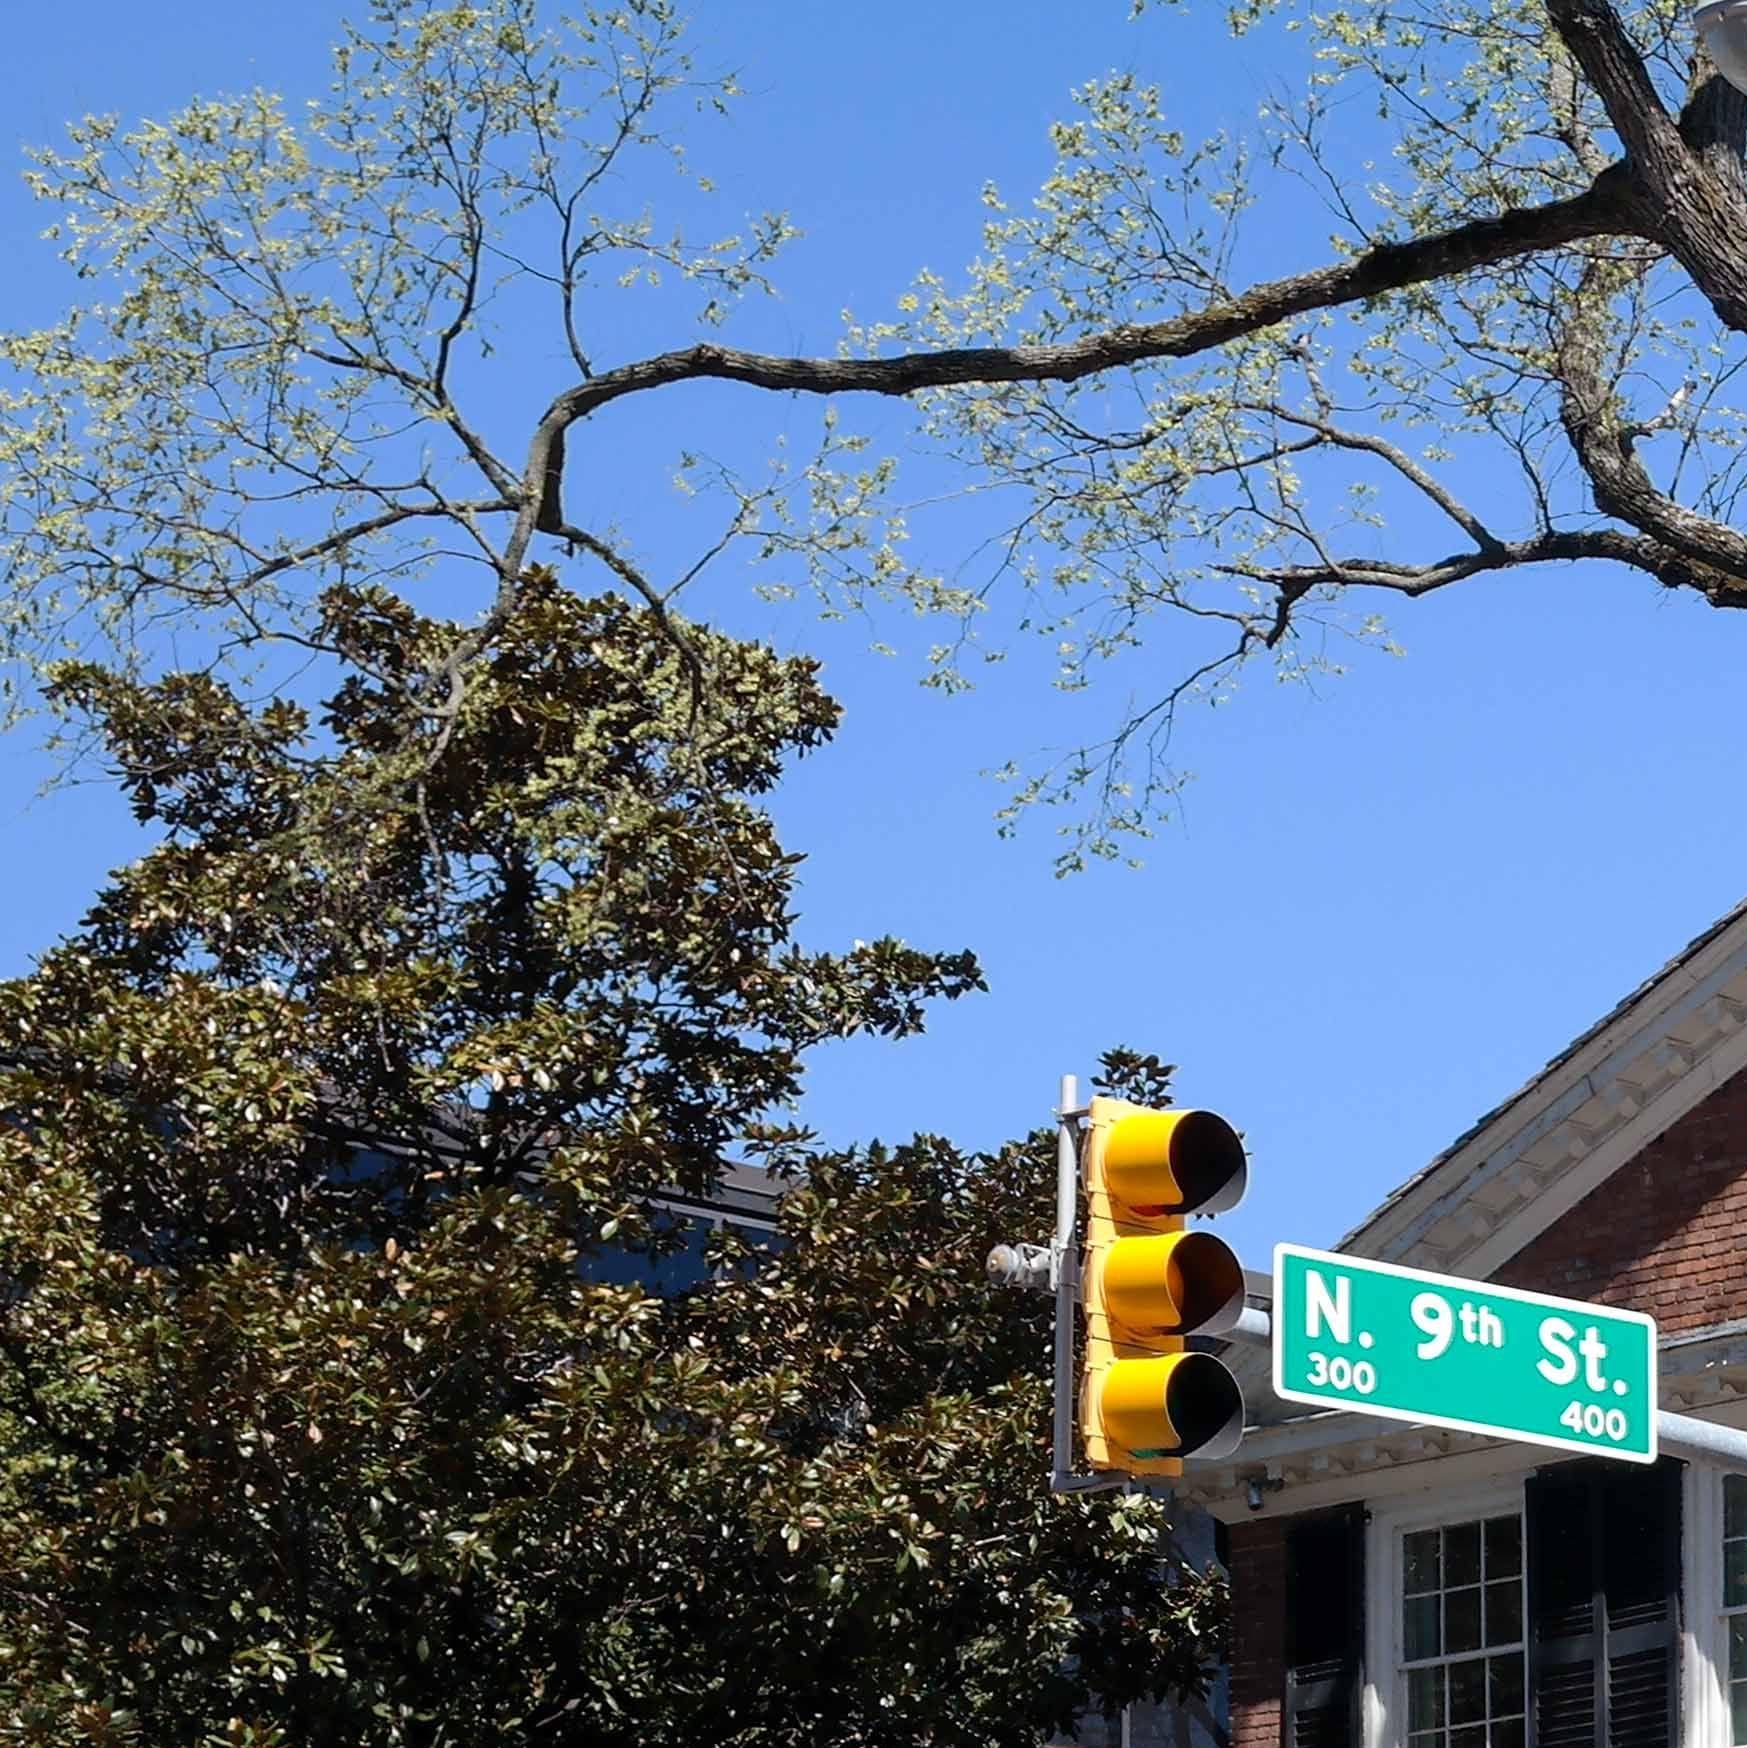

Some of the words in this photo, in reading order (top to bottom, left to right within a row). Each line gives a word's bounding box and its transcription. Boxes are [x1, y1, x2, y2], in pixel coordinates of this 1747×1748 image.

[1304, 1268, 1376, 1350] N.
[1409, 1291, 1503, 1361] 9th
[1535, 1316, 1631, 1397] St.
[1305, 1351, 1377, 1395] 300
[1559, 1400, 1628, 1441] 400
